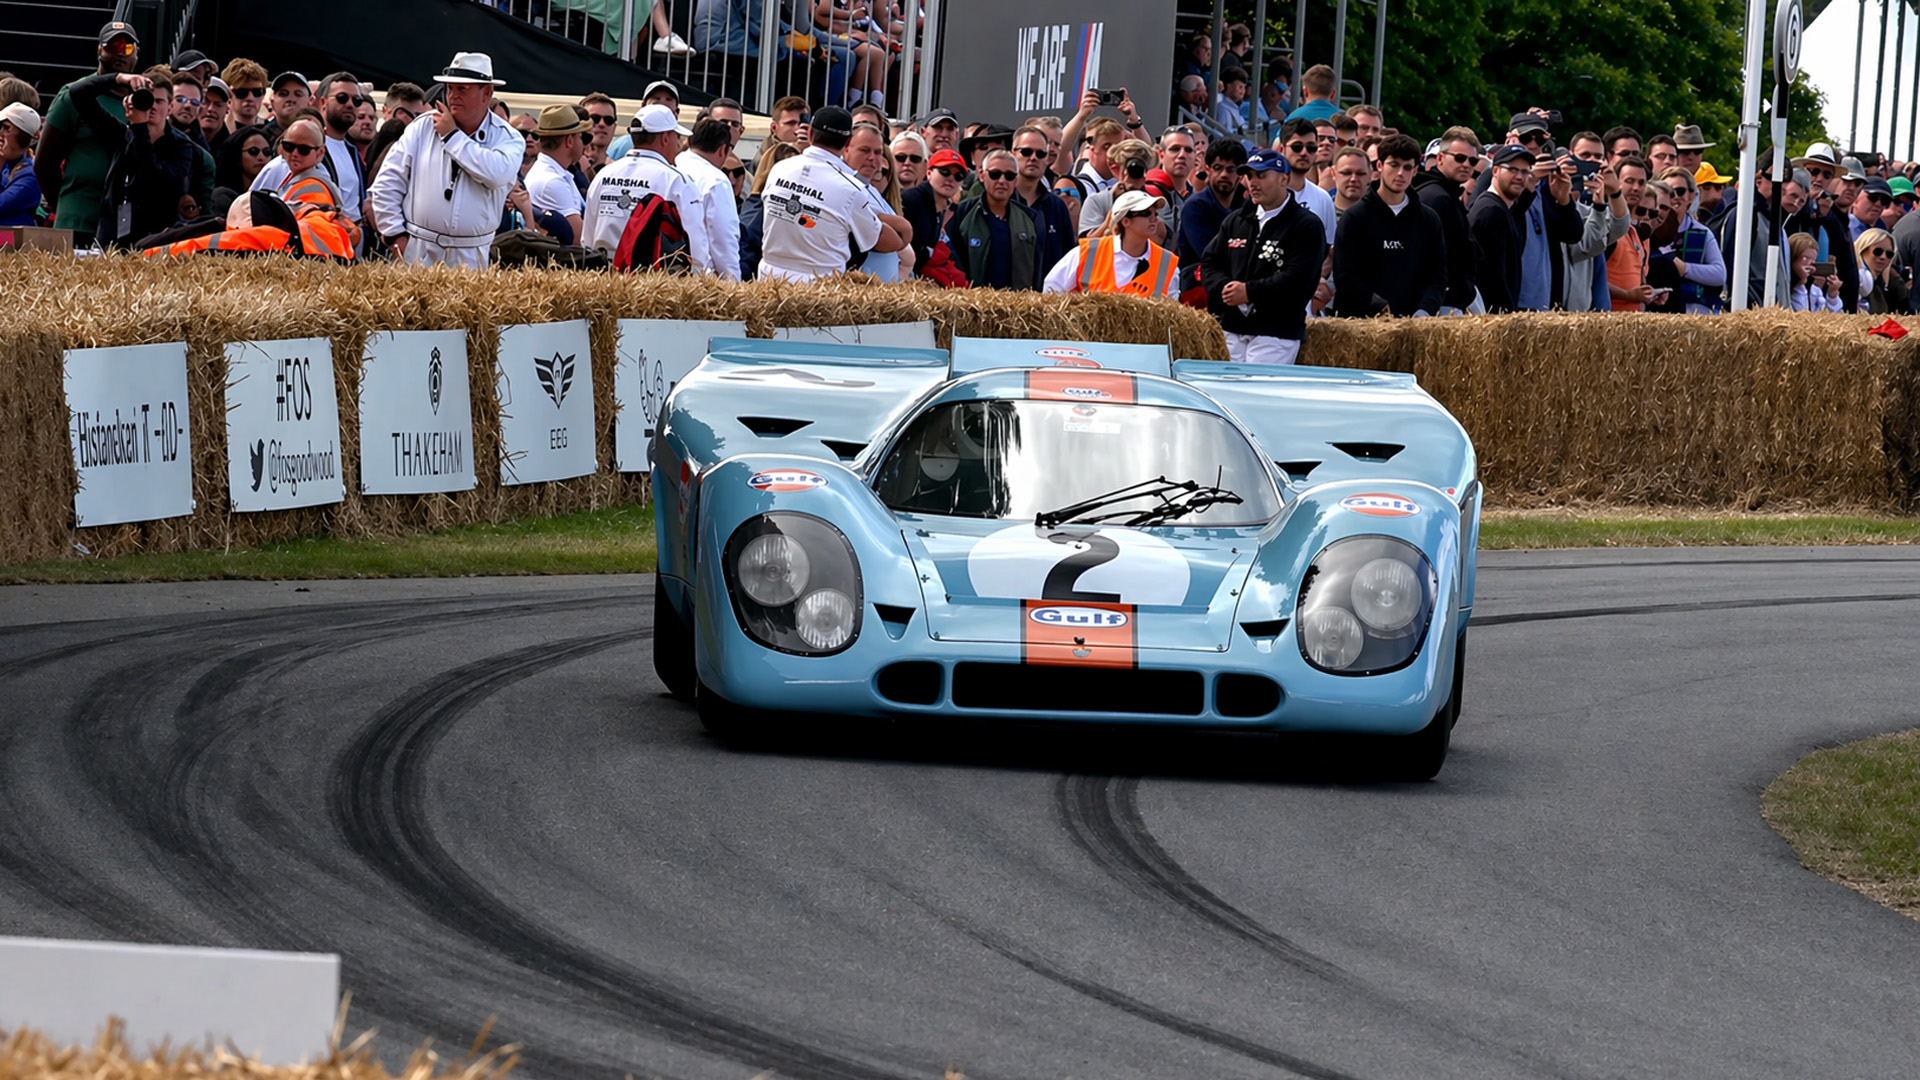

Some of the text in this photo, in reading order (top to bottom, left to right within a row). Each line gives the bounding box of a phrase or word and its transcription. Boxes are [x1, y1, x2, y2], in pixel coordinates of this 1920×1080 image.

[1015, 26, 1039, 111] WE
[1036, 24, 1070, 110] ARE
[602, 177, 651, 189] MARSHAL
[776, 178, 825, 201] MARSHAL
[276, 357, 312, 421] #FOS
[391, 431, 463, 477] THAKEHAM
[550, 427, 568, 450] EEG
[268, 438, 335, 497] @fosgoodwood
[1041, 532, 1121, 604] 2
[1034, 609, 1122, 624] Gulf
